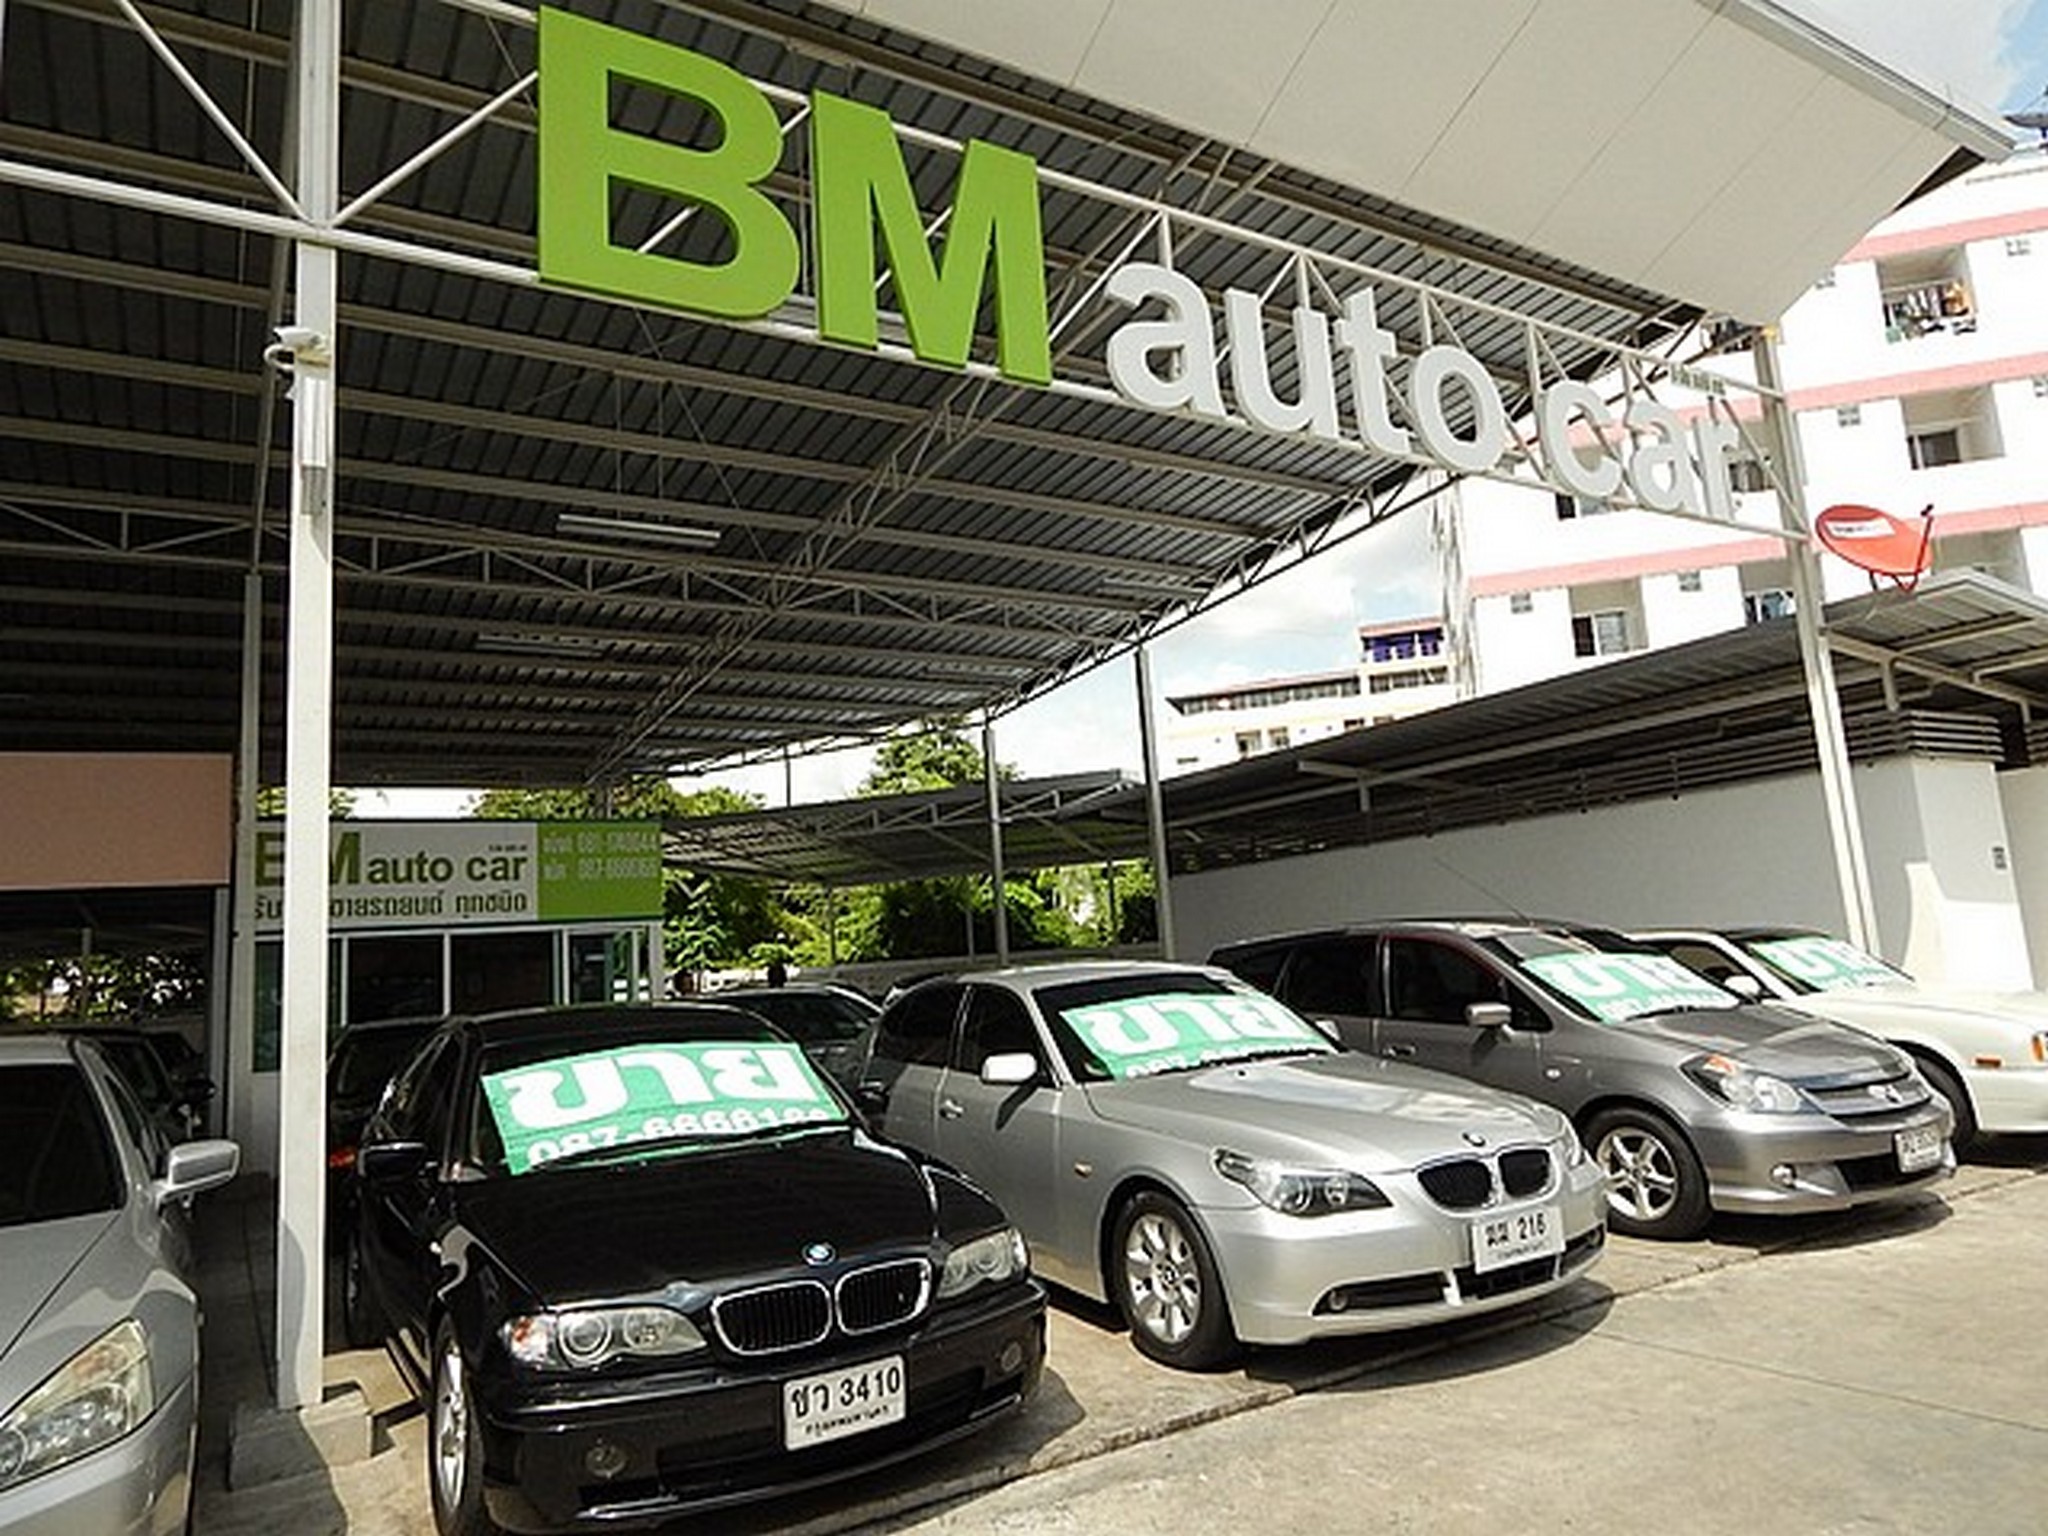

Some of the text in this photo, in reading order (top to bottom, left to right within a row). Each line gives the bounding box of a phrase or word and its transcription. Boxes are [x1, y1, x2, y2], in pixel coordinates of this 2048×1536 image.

[538, 4, 1739, 520] BM auto car
[368, 850, 453, 884] auto
[466, 856, 528, 881] car
[1078, 998, 1318, 1056] ขาย
[502, 1048, 819, 1130] ขาย
[840, 1365, 900, 1406] 3410
